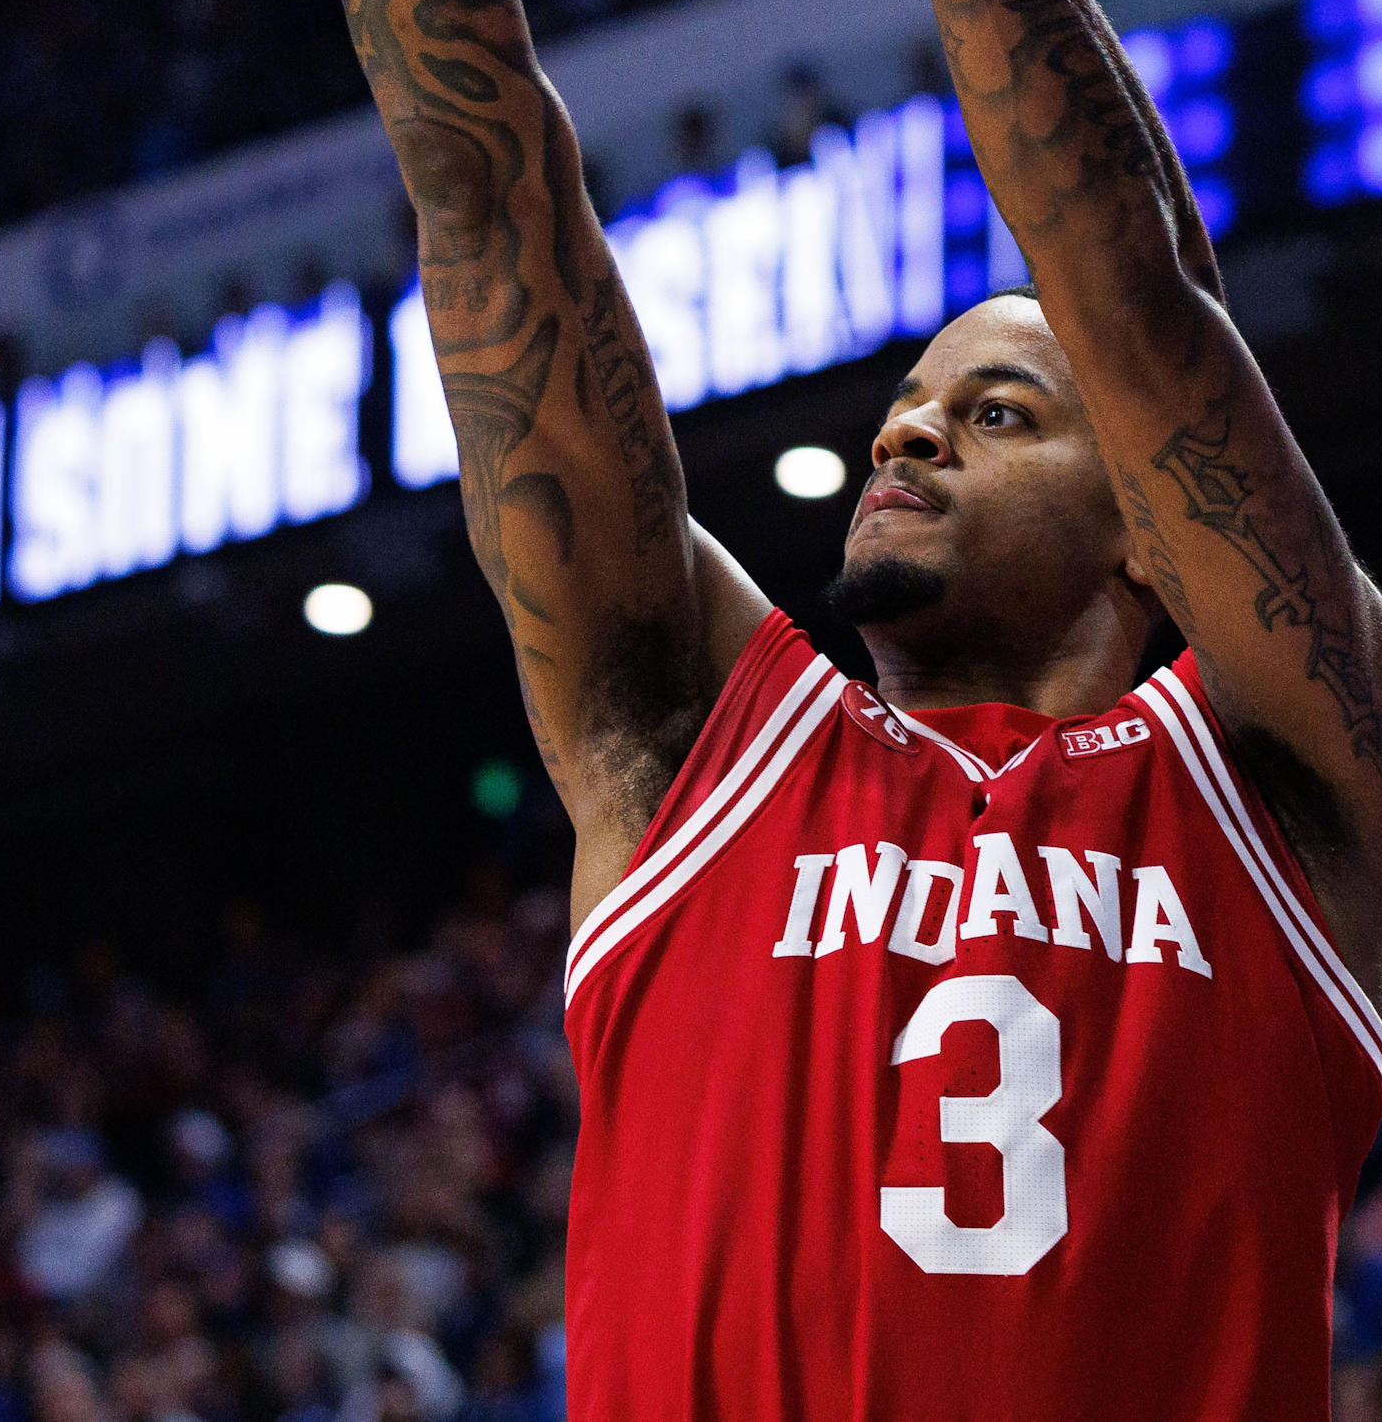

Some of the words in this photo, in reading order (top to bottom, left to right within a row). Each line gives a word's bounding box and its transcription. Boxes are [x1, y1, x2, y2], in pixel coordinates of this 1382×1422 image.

[17, 313, 363, 600] SOME
[771, 831, 1213, 980] INDANA
[879, 973, 1069, 1276] 3
